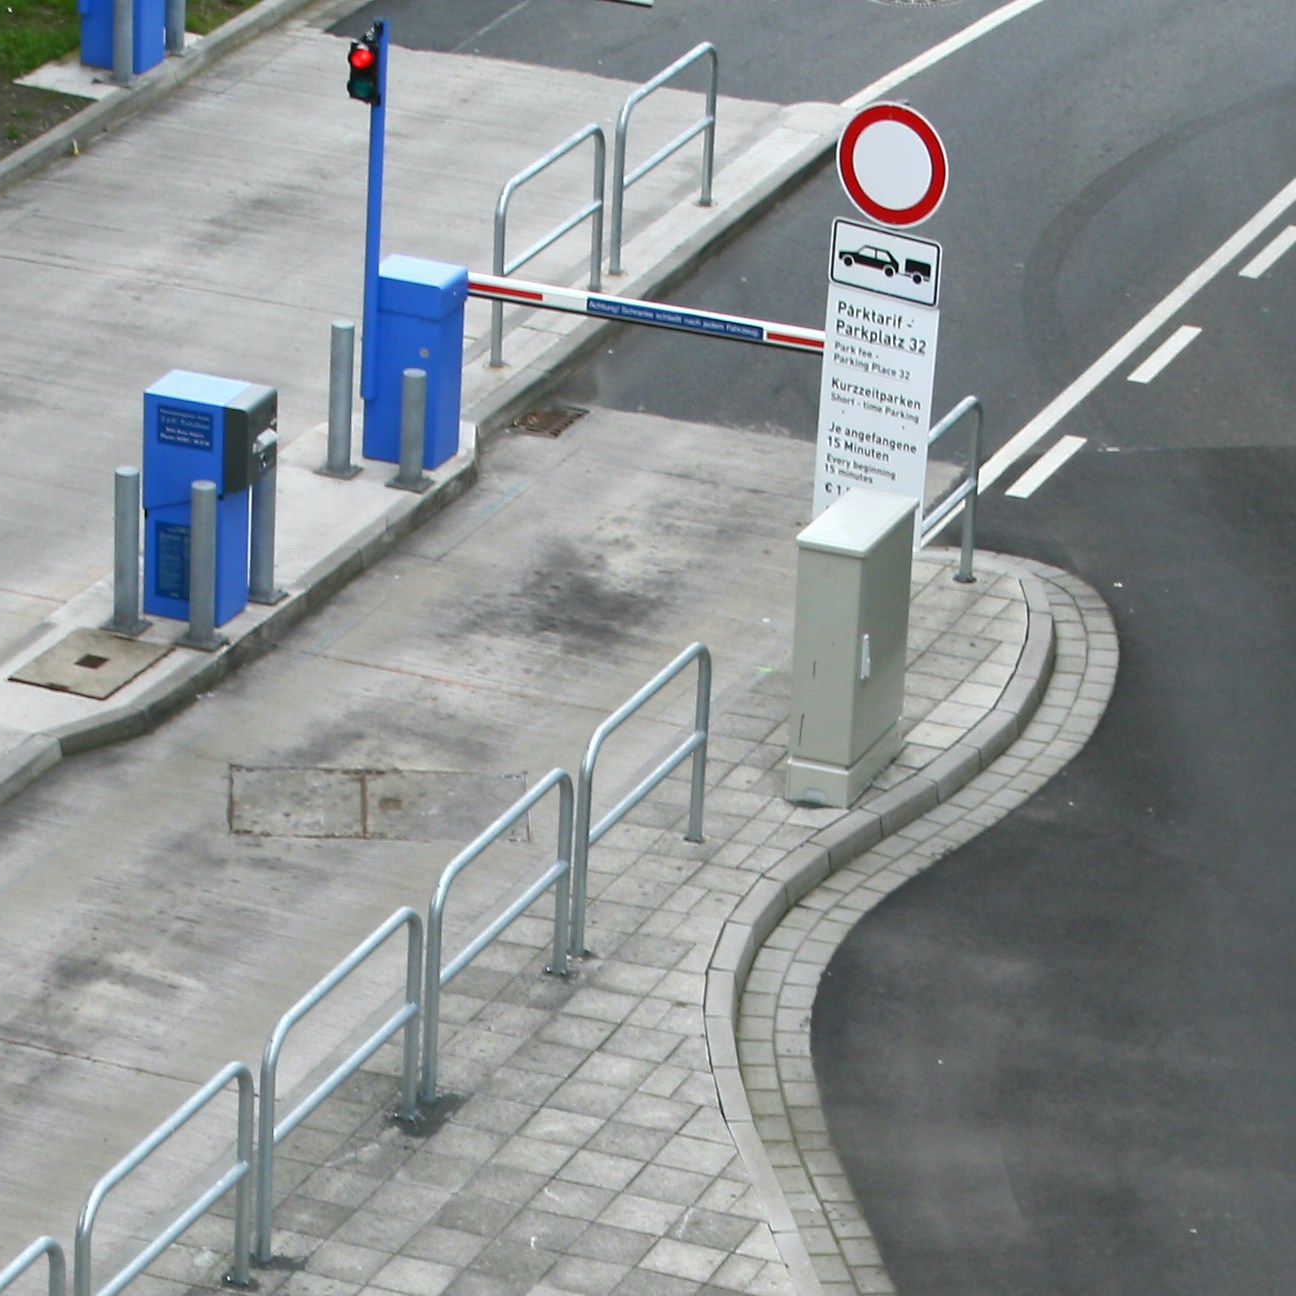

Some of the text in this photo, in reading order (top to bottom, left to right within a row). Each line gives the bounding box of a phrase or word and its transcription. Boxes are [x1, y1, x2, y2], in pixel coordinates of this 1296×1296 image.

[588, 300, 621, 314] Achtung!
[837, 301, 904, 330] Parktarif
[834, 341, 856, 354] Park
[858, 345, 873, 359] fee
[835, 319, 927, 355] Parkplatz 32
[833, 353, 911, 381] Parking Place 32
[831, 377, 922, 410] Kurzzeitparken
[830, 392, 855, 406] Short
[863, 400, 883, 413] time
[884, 405, 920, 425] Parking
[827, 435, 891, 463] 15 Minuten
[828, 421, 918, 455] Je angefangene
[825, 463, 874, 485] 15 minutes
[826, 452, 897, 481] Every beginning
[824, 482, 833, 493] €
